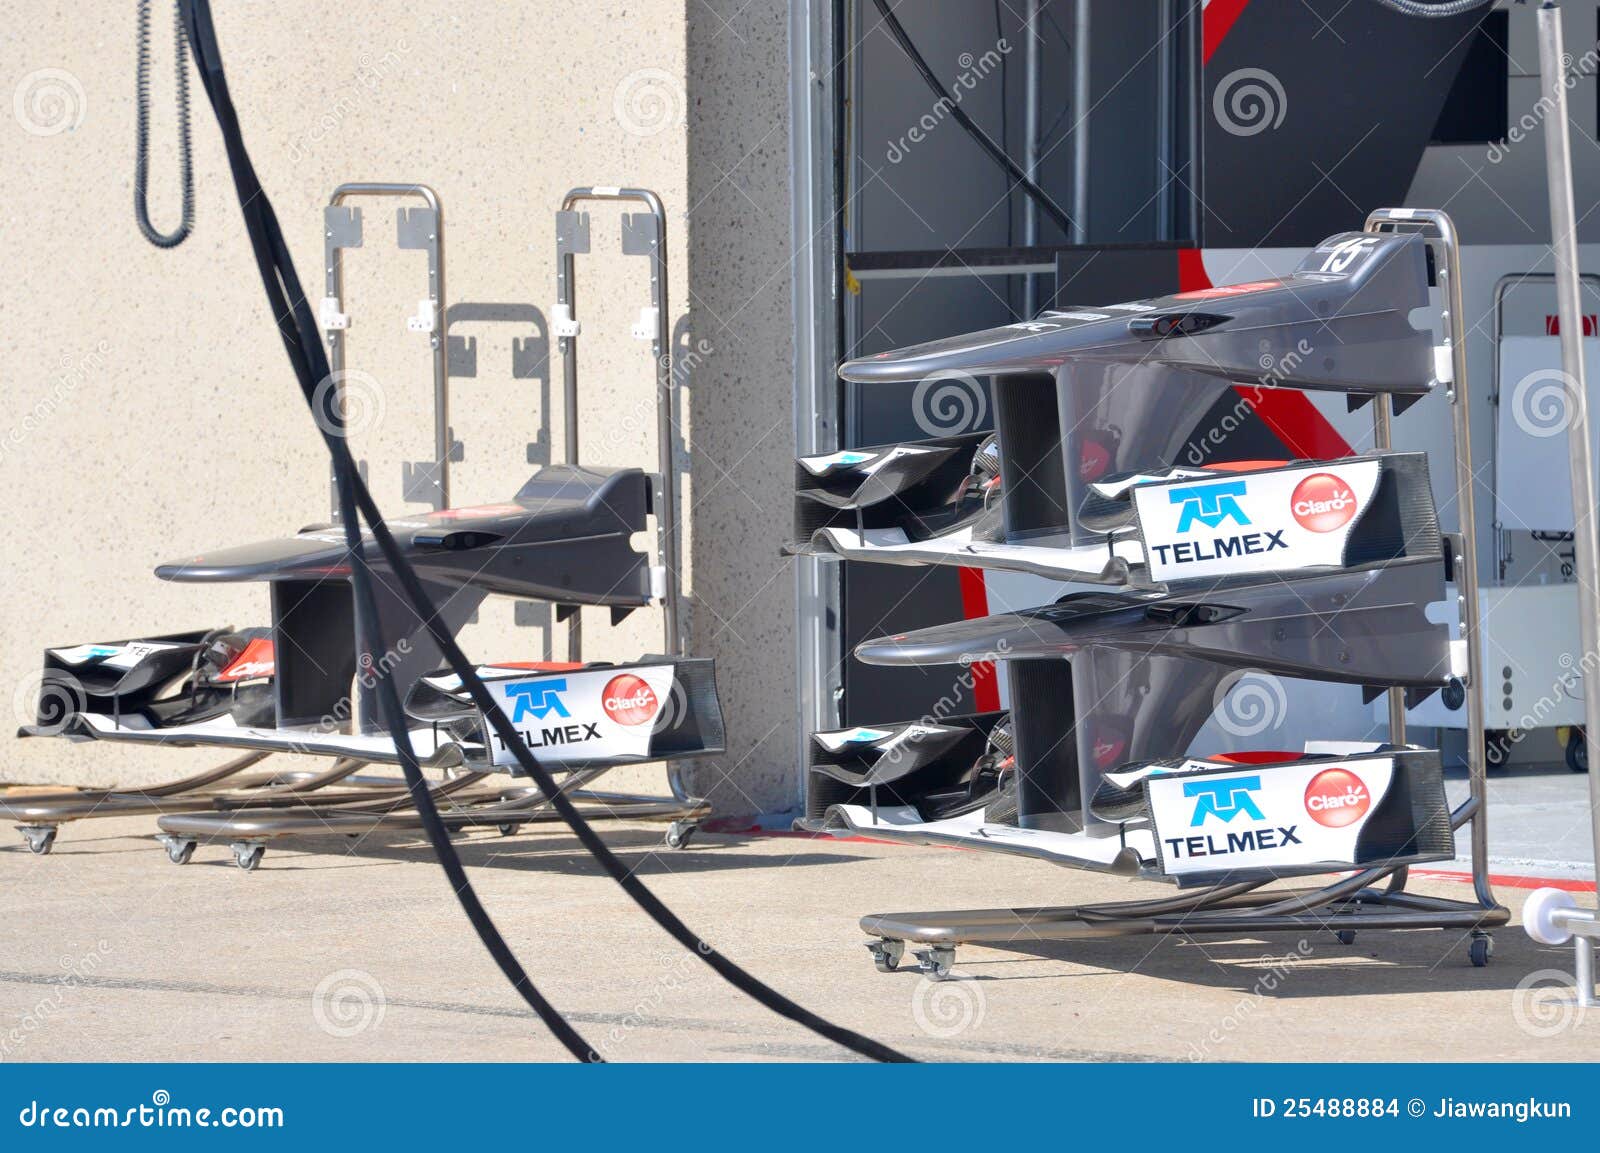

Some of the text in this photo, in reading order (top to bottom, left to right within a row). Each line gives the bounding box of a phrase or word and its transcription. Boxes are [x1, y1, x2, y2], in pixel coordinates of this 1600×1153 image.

[1320, 237, 1381, 272] 15
[1294, 494, 1350, 516] Claro
[1152, 529, 1289, 565] TELMEX
[604, 690, 650, 711] Claro
[1307, 788, 1362, 811] Claro
[1165, 825, 1303, 858] TELMEX
